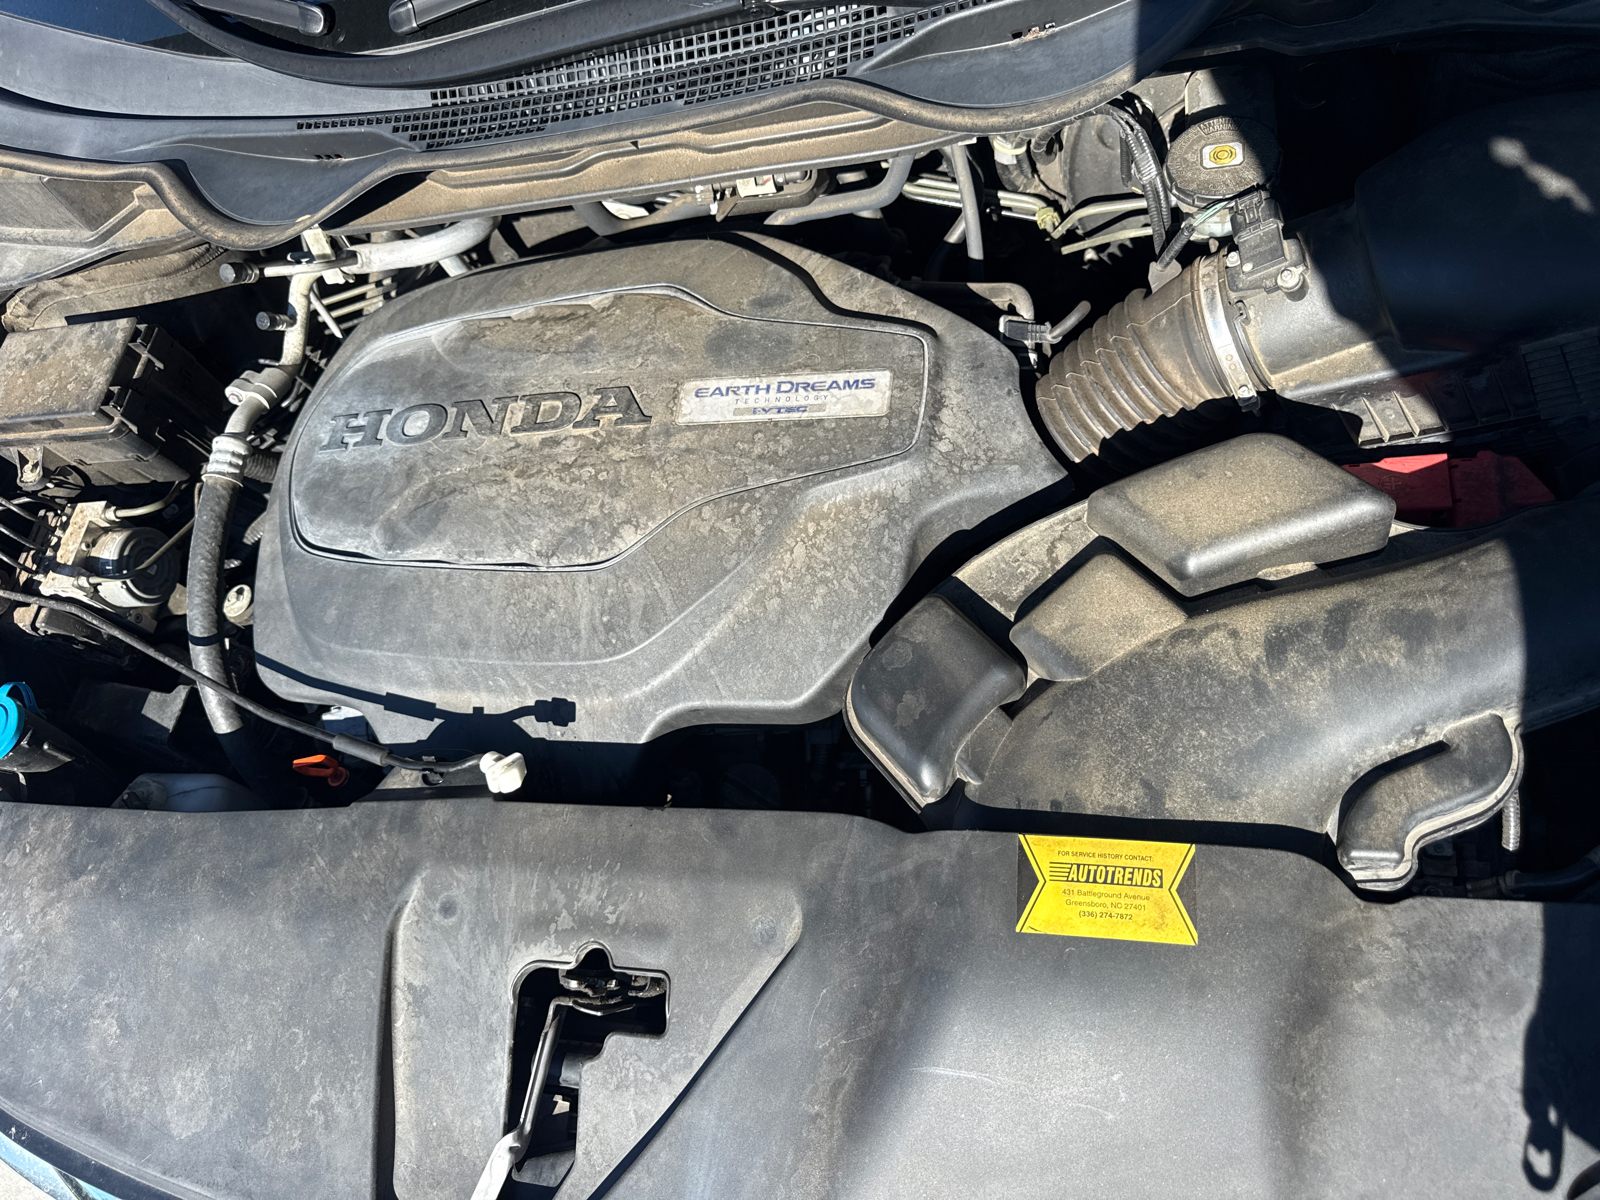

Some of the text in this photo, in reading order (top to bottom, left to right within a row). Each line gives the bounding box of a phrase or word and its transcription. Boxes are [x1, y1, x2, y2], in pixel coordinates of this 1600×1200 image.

[1203, 123, 1239, 134] WARNING
[694, 378, 876, 399] EARTH DREAMS
[734, 394, 830, 406] TECHNOLOGY
[319, 385, 653, 452] HONDA
[1071, 851, 1097, 859] SERVICE
[1097, 852, 1124, 861] HISTORY
[1124, 854, 1155, 862] CONTACT:
[1067, 864, 1162, 887] AUTOTRENDS
[1061, 888, 1151, 901] 431 Battleground Avenue
[1065, 898, 1109, 909] Greensboro,
[1124, 902, 1147, 911] 27401
[1078, 910, 1133, 921] (336) 274-7872
